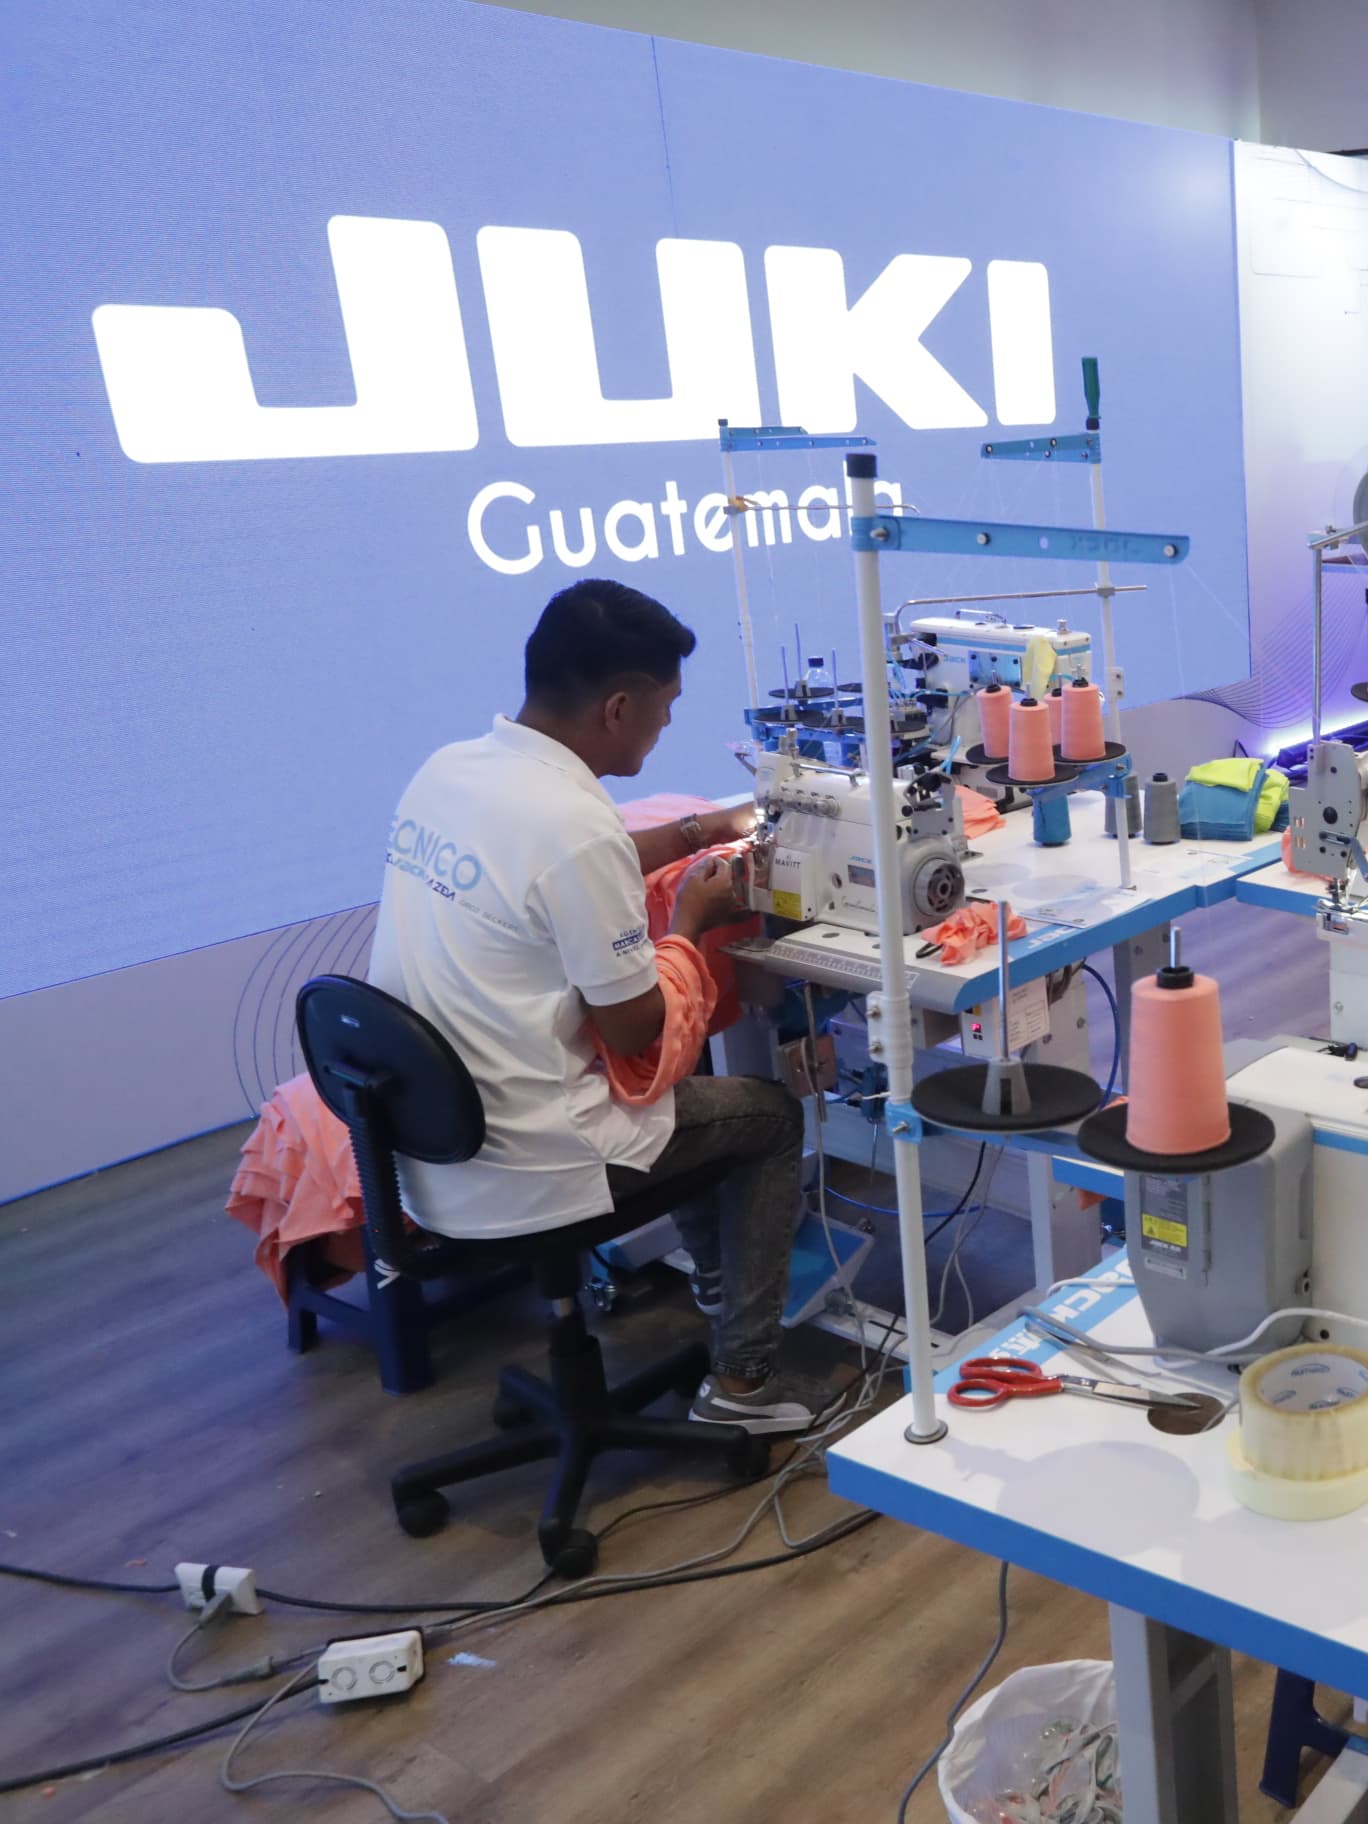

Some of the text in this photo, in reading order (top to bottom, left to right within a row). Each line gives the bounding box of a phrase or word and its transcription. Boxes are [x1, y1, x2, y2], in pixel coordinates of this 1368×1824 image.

[92, 215, 1056, 463] JUKI
[391, 819, 482, 891] CNICO
[775, 858, 801, 869] MAVITT
